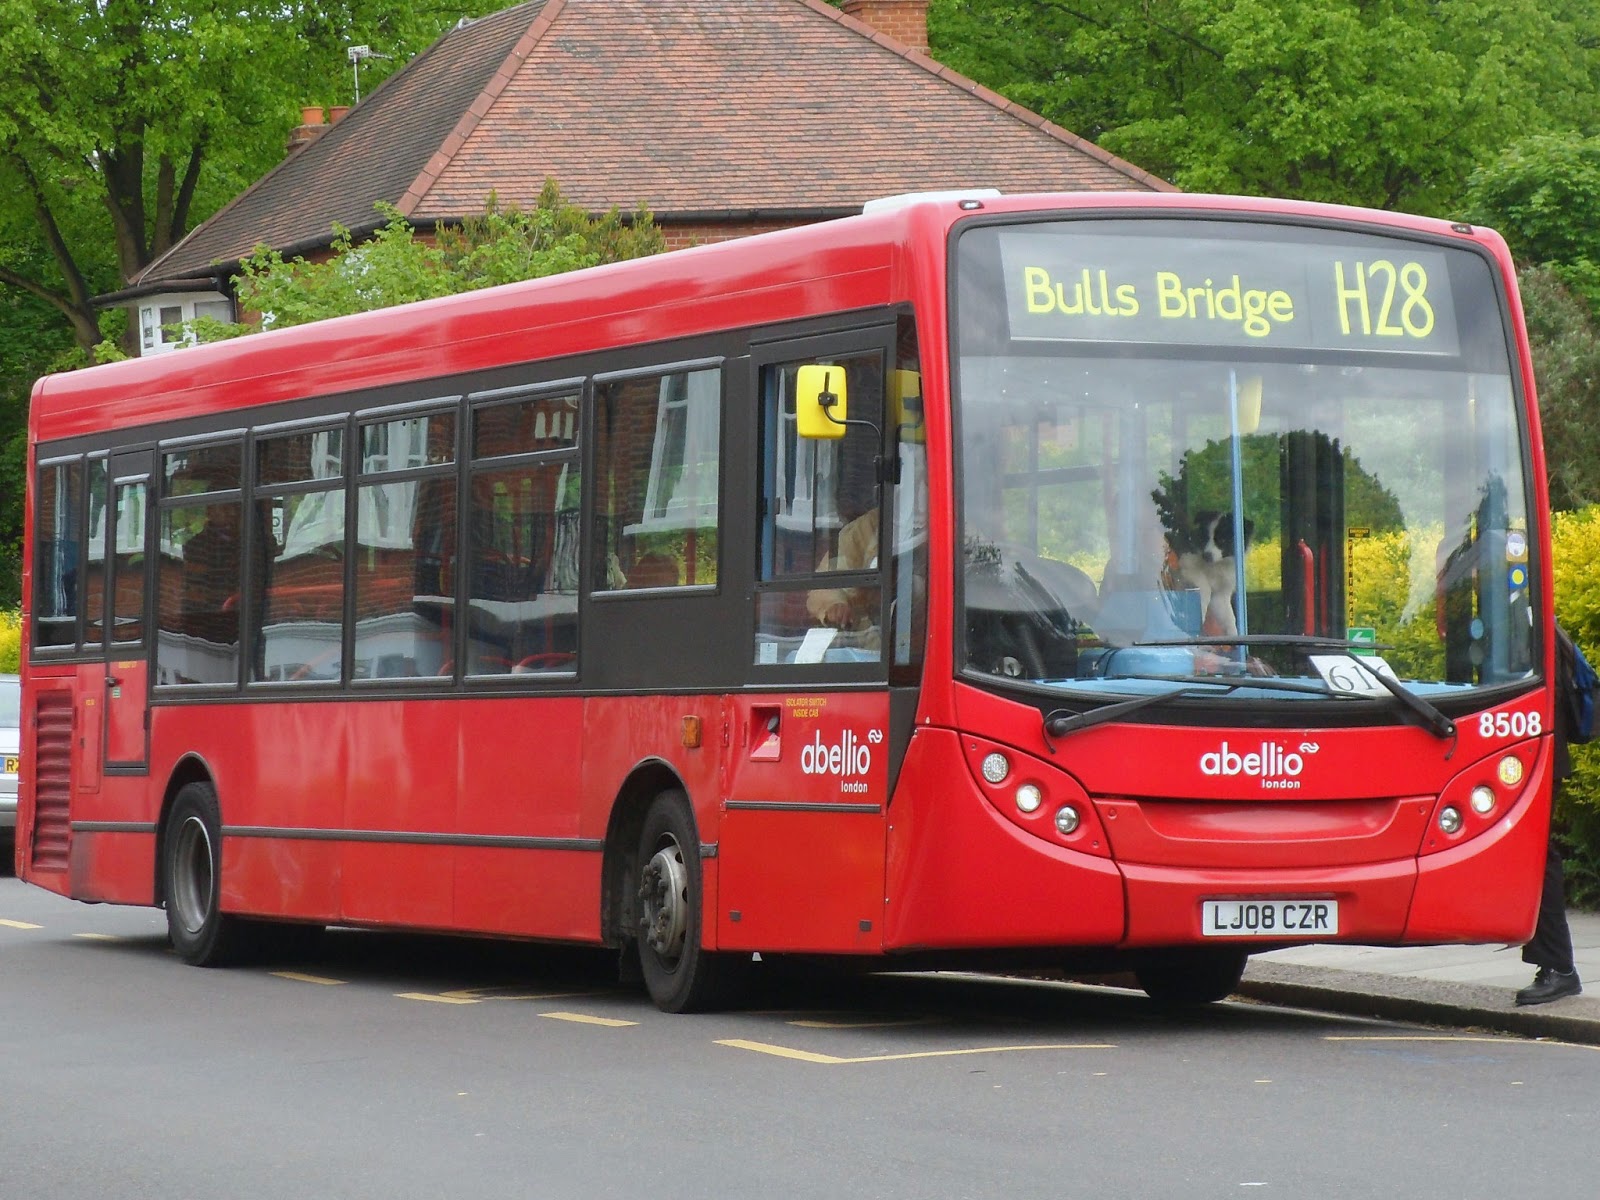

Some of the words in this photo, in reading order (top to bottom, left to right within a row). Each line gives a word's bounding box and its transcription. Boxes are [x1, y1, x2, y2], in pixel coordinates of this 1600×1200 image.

[1024, 266, 1140, 316] Bulls
[1156, 270, 1294, 337] Bridge
[1334, 259, 1435, 338] H28
[1328, 664, 1387, 692] 61
[1479, 711, 1542, 738] 8508
[801, 729, 871, 776] abellio
[1200, 741, 1304, 777] abellio
[841, 780, 868, 793] london
[1262, 778, 1301, 789] london
[1214, 904, 1276, 930] LJ08
[1283, 904, 1329, 929] CZR
